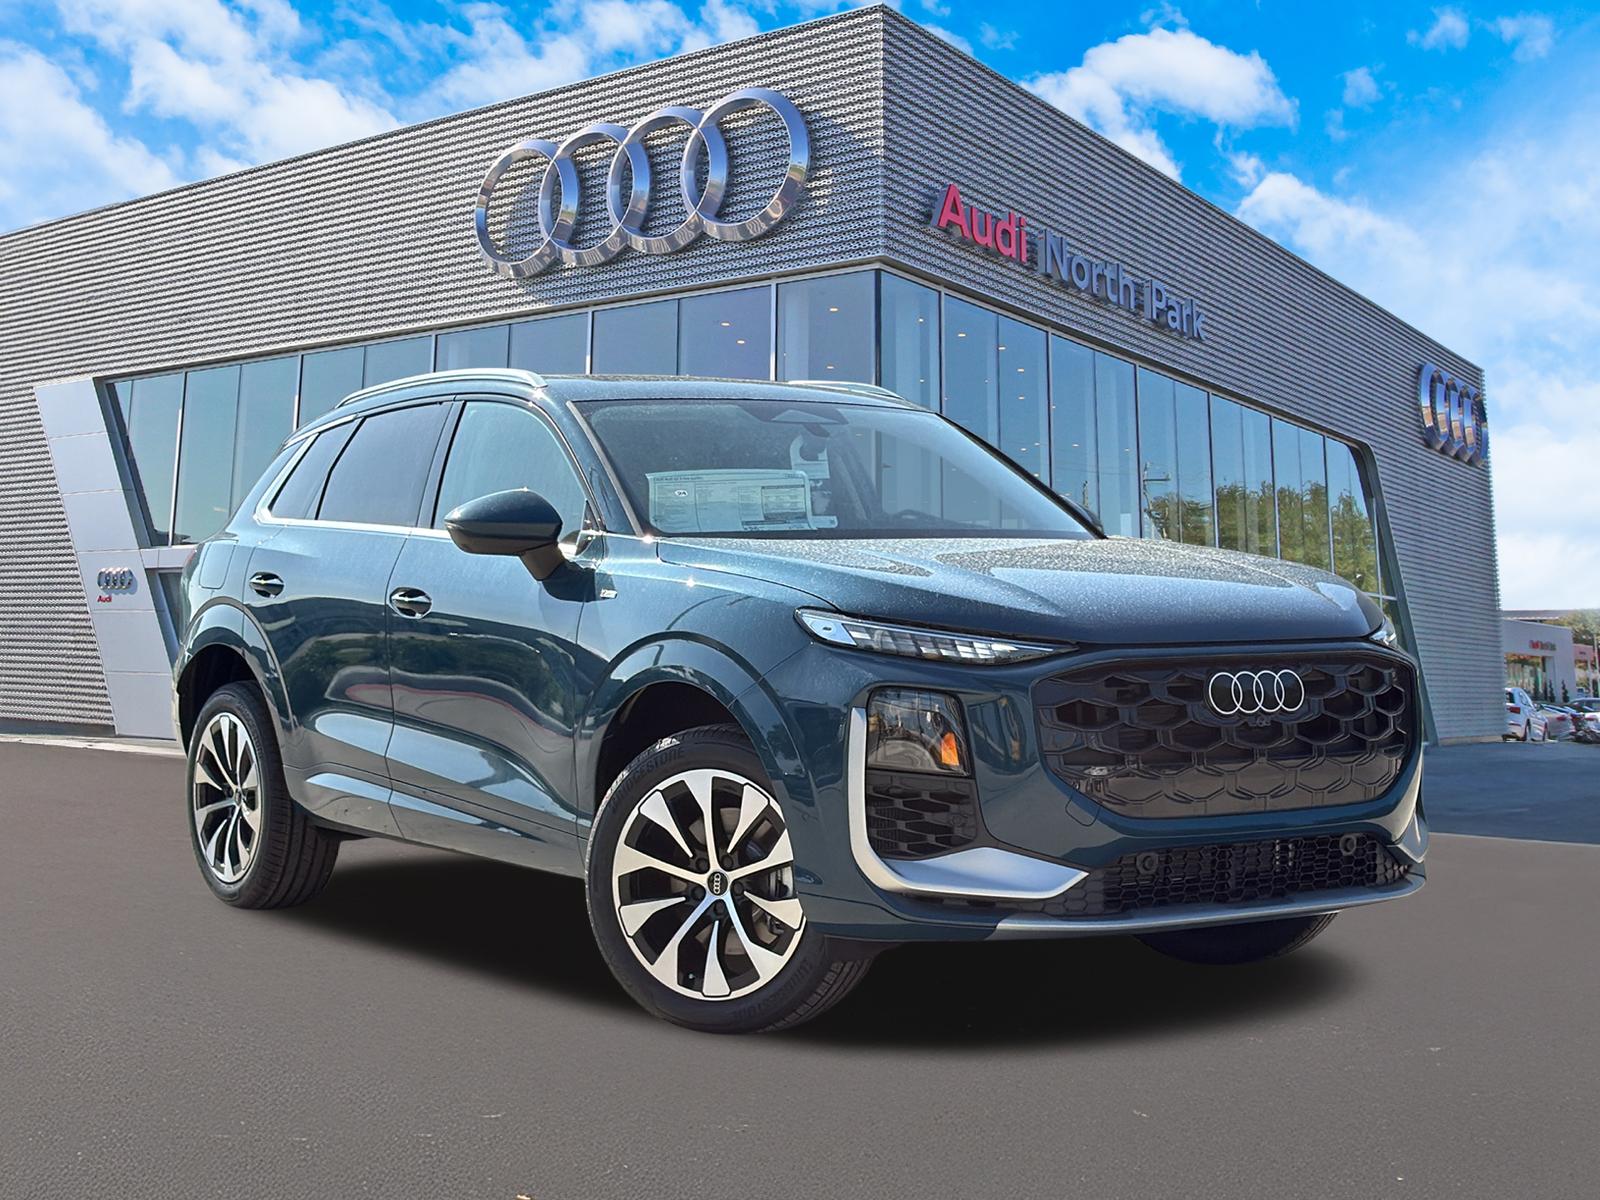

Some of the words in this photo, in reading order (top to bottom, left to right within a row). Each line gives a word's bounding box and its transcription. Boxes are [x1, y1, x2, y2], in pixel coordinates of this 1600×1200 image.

[936, 183, 1028, 264] Audi
[1044, 229, 1136, 310] North
[1150, 279, 1207, 340] Park
